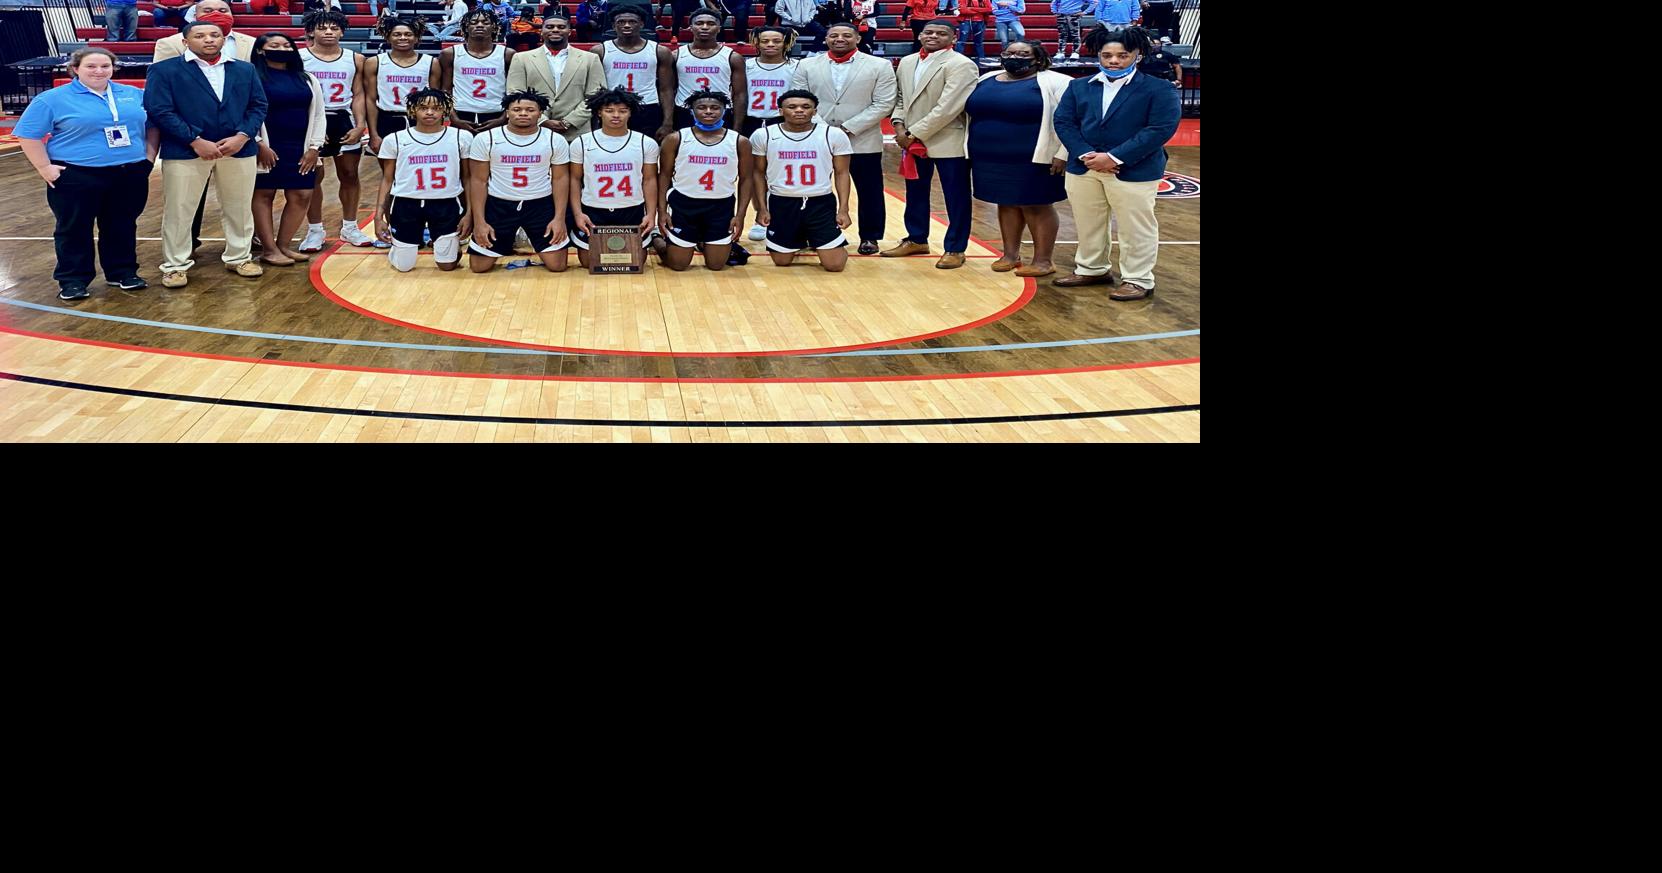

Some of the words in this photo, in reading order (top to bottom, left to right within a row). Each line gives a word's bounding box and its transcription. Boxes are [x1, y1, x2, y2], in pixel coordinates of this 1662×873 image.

[461, 67, 496, 75] MIDFIELD
[613, 61, 648, 70] MIDFIELD
[685, 66, 720, 74] MIDFIELD
[386, 75, 422, 83] MIDFIELD
[626, 73, 634, 92] 1
[751, 79, 785, 87] MIDFIELD
[320, 83, 344, 102] 2
[472, 79, 486, 98] 2
[751, 90, 778, 110] 21
[408, 154, 448, 165] MIDFIELD
[500, 155, 541, 163] MIDFIELD
[688, 155, 728, 165] MIDFIELD
[778, 151, 817, 160] MIDFIELD
[593, 162, 633, 172] MIDFIELD
[415, 167, 447, 190] 15
[512, 167, 529, 188] 5
[698, 169, 715, 191] 4
[784, 164, 816, 185] 10
[597, 175, 633, 198] 24
